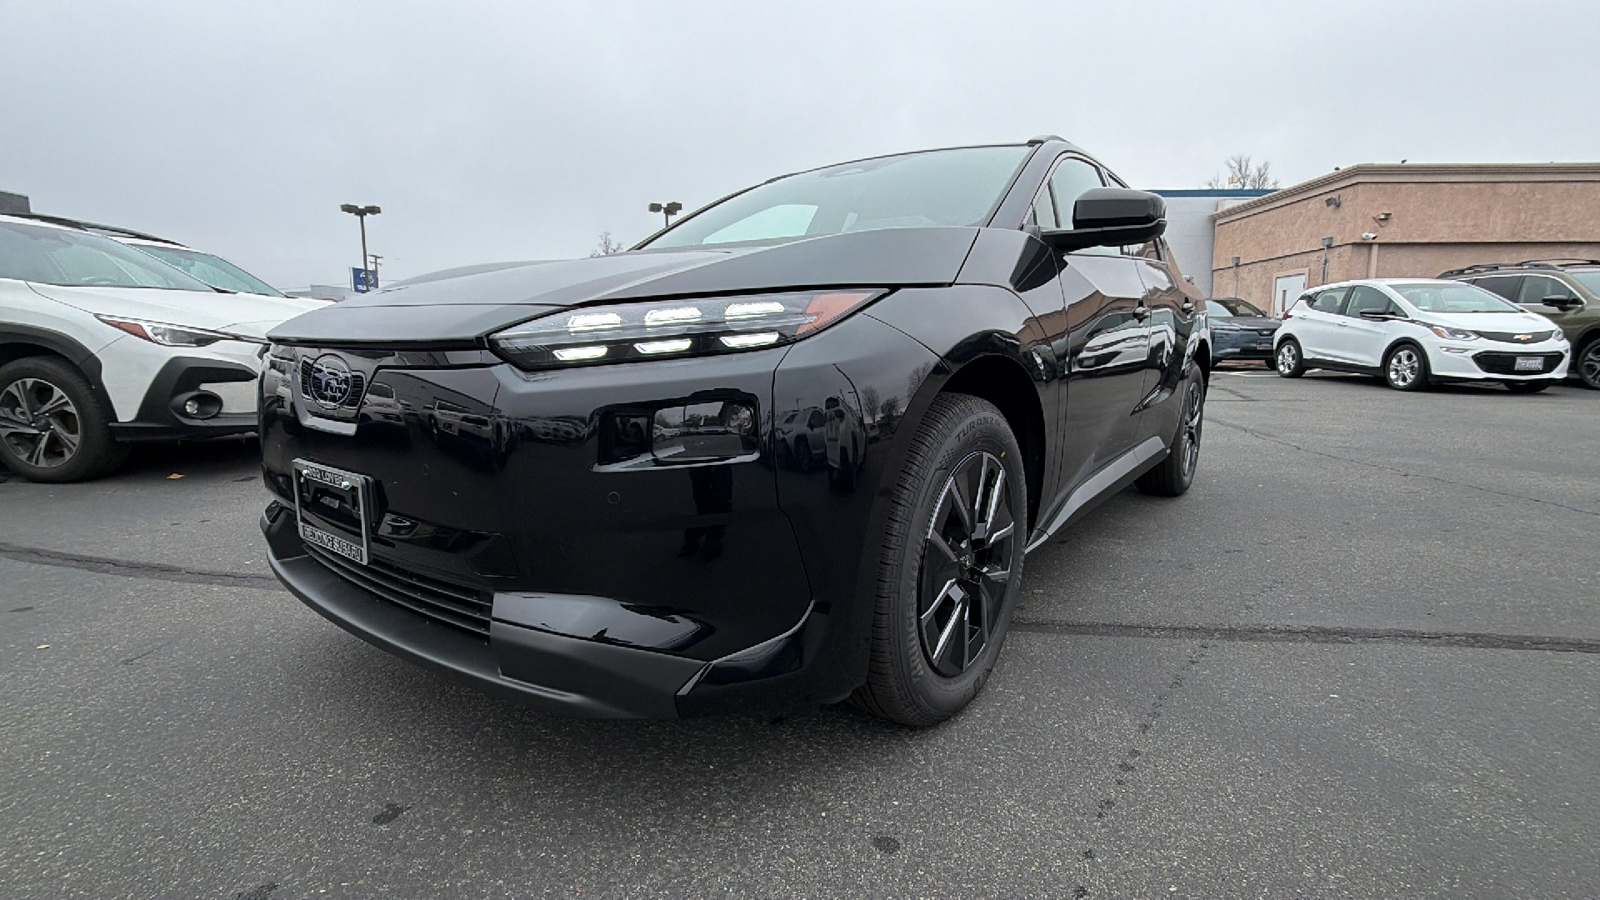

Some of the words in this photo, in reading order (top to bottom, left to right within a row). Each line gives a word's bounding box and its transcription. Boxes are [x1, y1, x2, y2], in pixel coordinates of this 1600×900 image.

[955, 416, 1000, 442] TURANZA
[303, 526, 333, 549] REDDING
[332, 537, 362, 561] SUBARU
